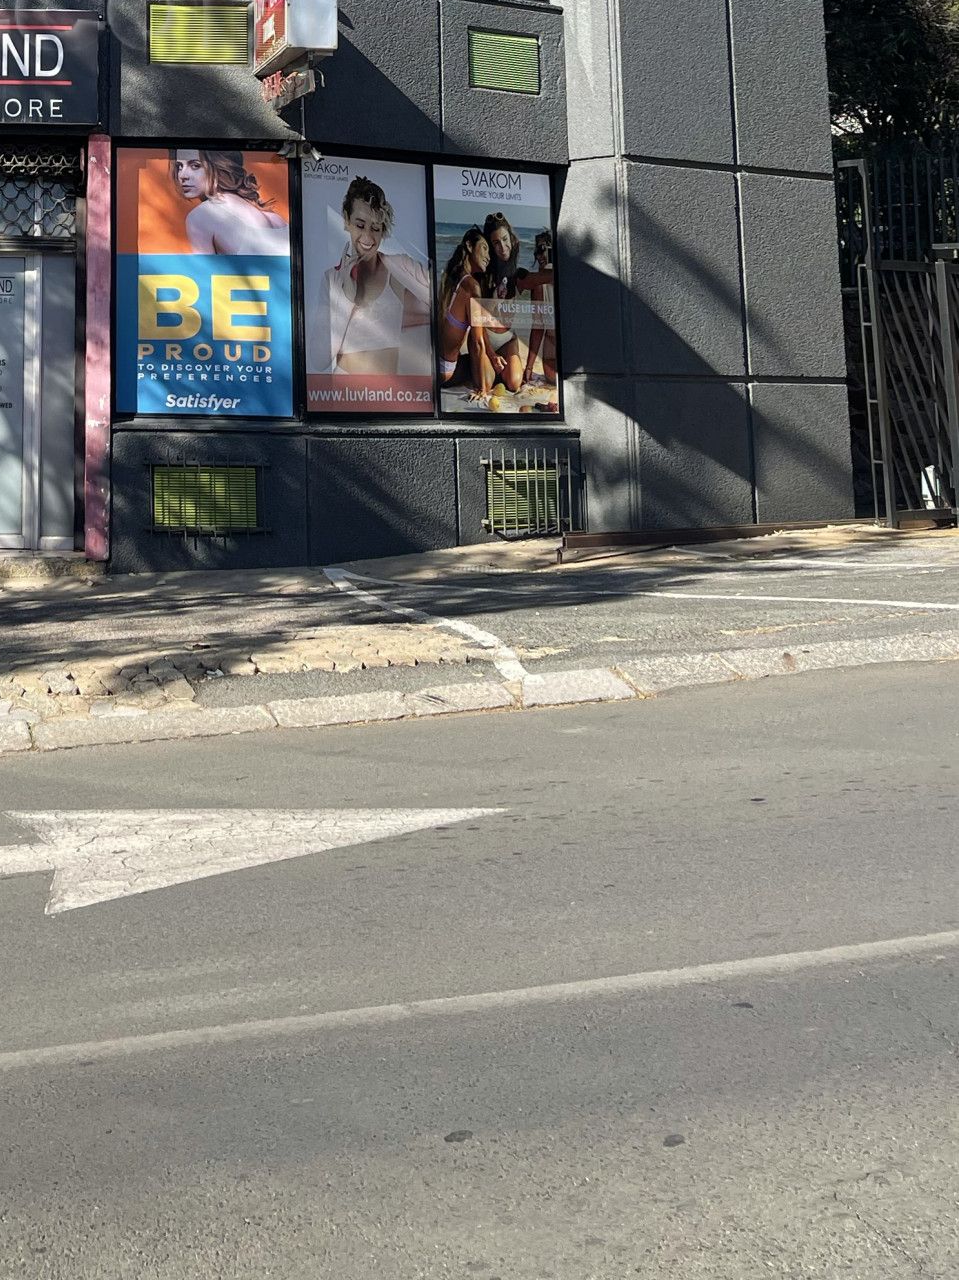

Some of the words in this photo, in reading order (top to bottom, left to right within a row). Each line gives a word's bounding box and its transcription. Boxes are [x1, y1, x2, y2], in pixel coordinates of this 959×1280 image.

[303, 161, 349, 175] SVAKOM
[461, 169, 522, 190] SVAKOM
[138, 274, 272, 342] BE
[138, 343, 272, 363] PROUD
[138, 363, 155, 371] TO
[161, 364, 230, 372] DISCOVER
[236, 365, 272, 374] YOUR
[138, 372, 273, 383] PREFERENCES
[165, 393, 241, 411] Satisfyer
[308, 386, 431, 402] www.luvland.co.za
